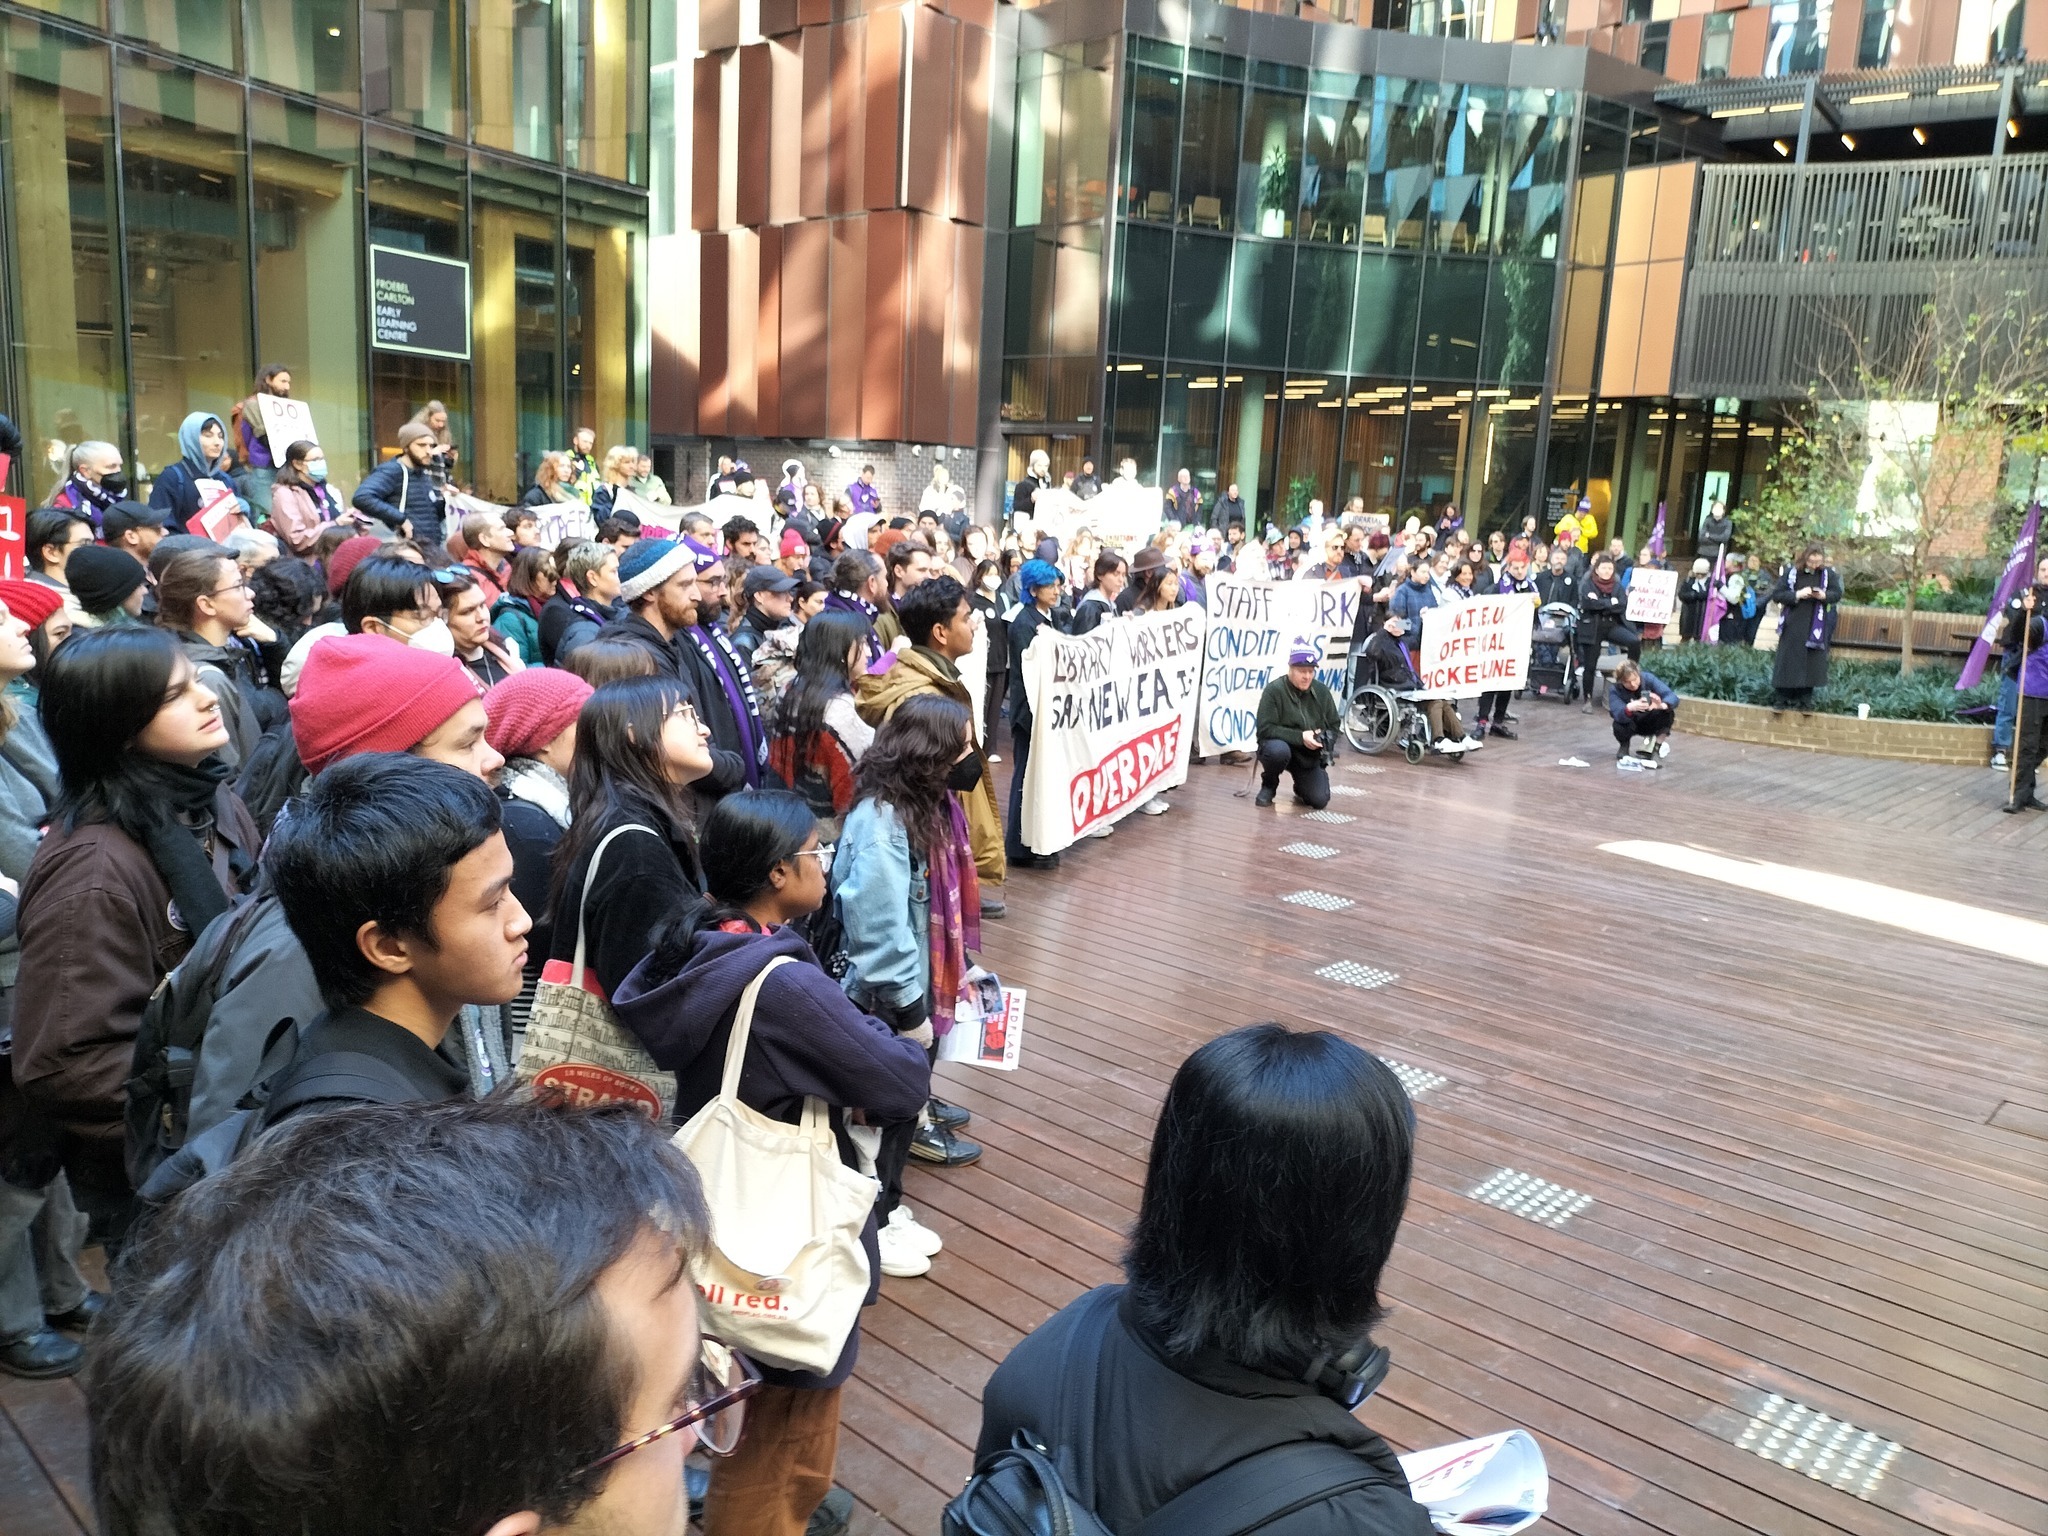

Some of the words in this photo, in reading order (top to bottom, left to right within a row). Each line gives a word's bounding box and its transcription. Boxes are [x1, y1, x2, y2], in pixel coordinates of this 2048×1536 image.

[376, 290, 415, 306] CARLTON
[376, 305, 402, 318] EARLY
[377, 316, 418, 333] LEARNING
[377, 328, 408, 343] CENTRE
[272, 401, 299, 420] DO
[1213, 582, 1274, 622] STAFF
[1122, 617, 1199, 669] WORKERS
[1481, 659, 1517, 680] LINE
[1088, 676, 1132, 733] NEW
[1137, 668, 1174, 718] EA
[1072, 723, 1181, 828] OVERDUE
[733, 1294, 789, 1312] red.
